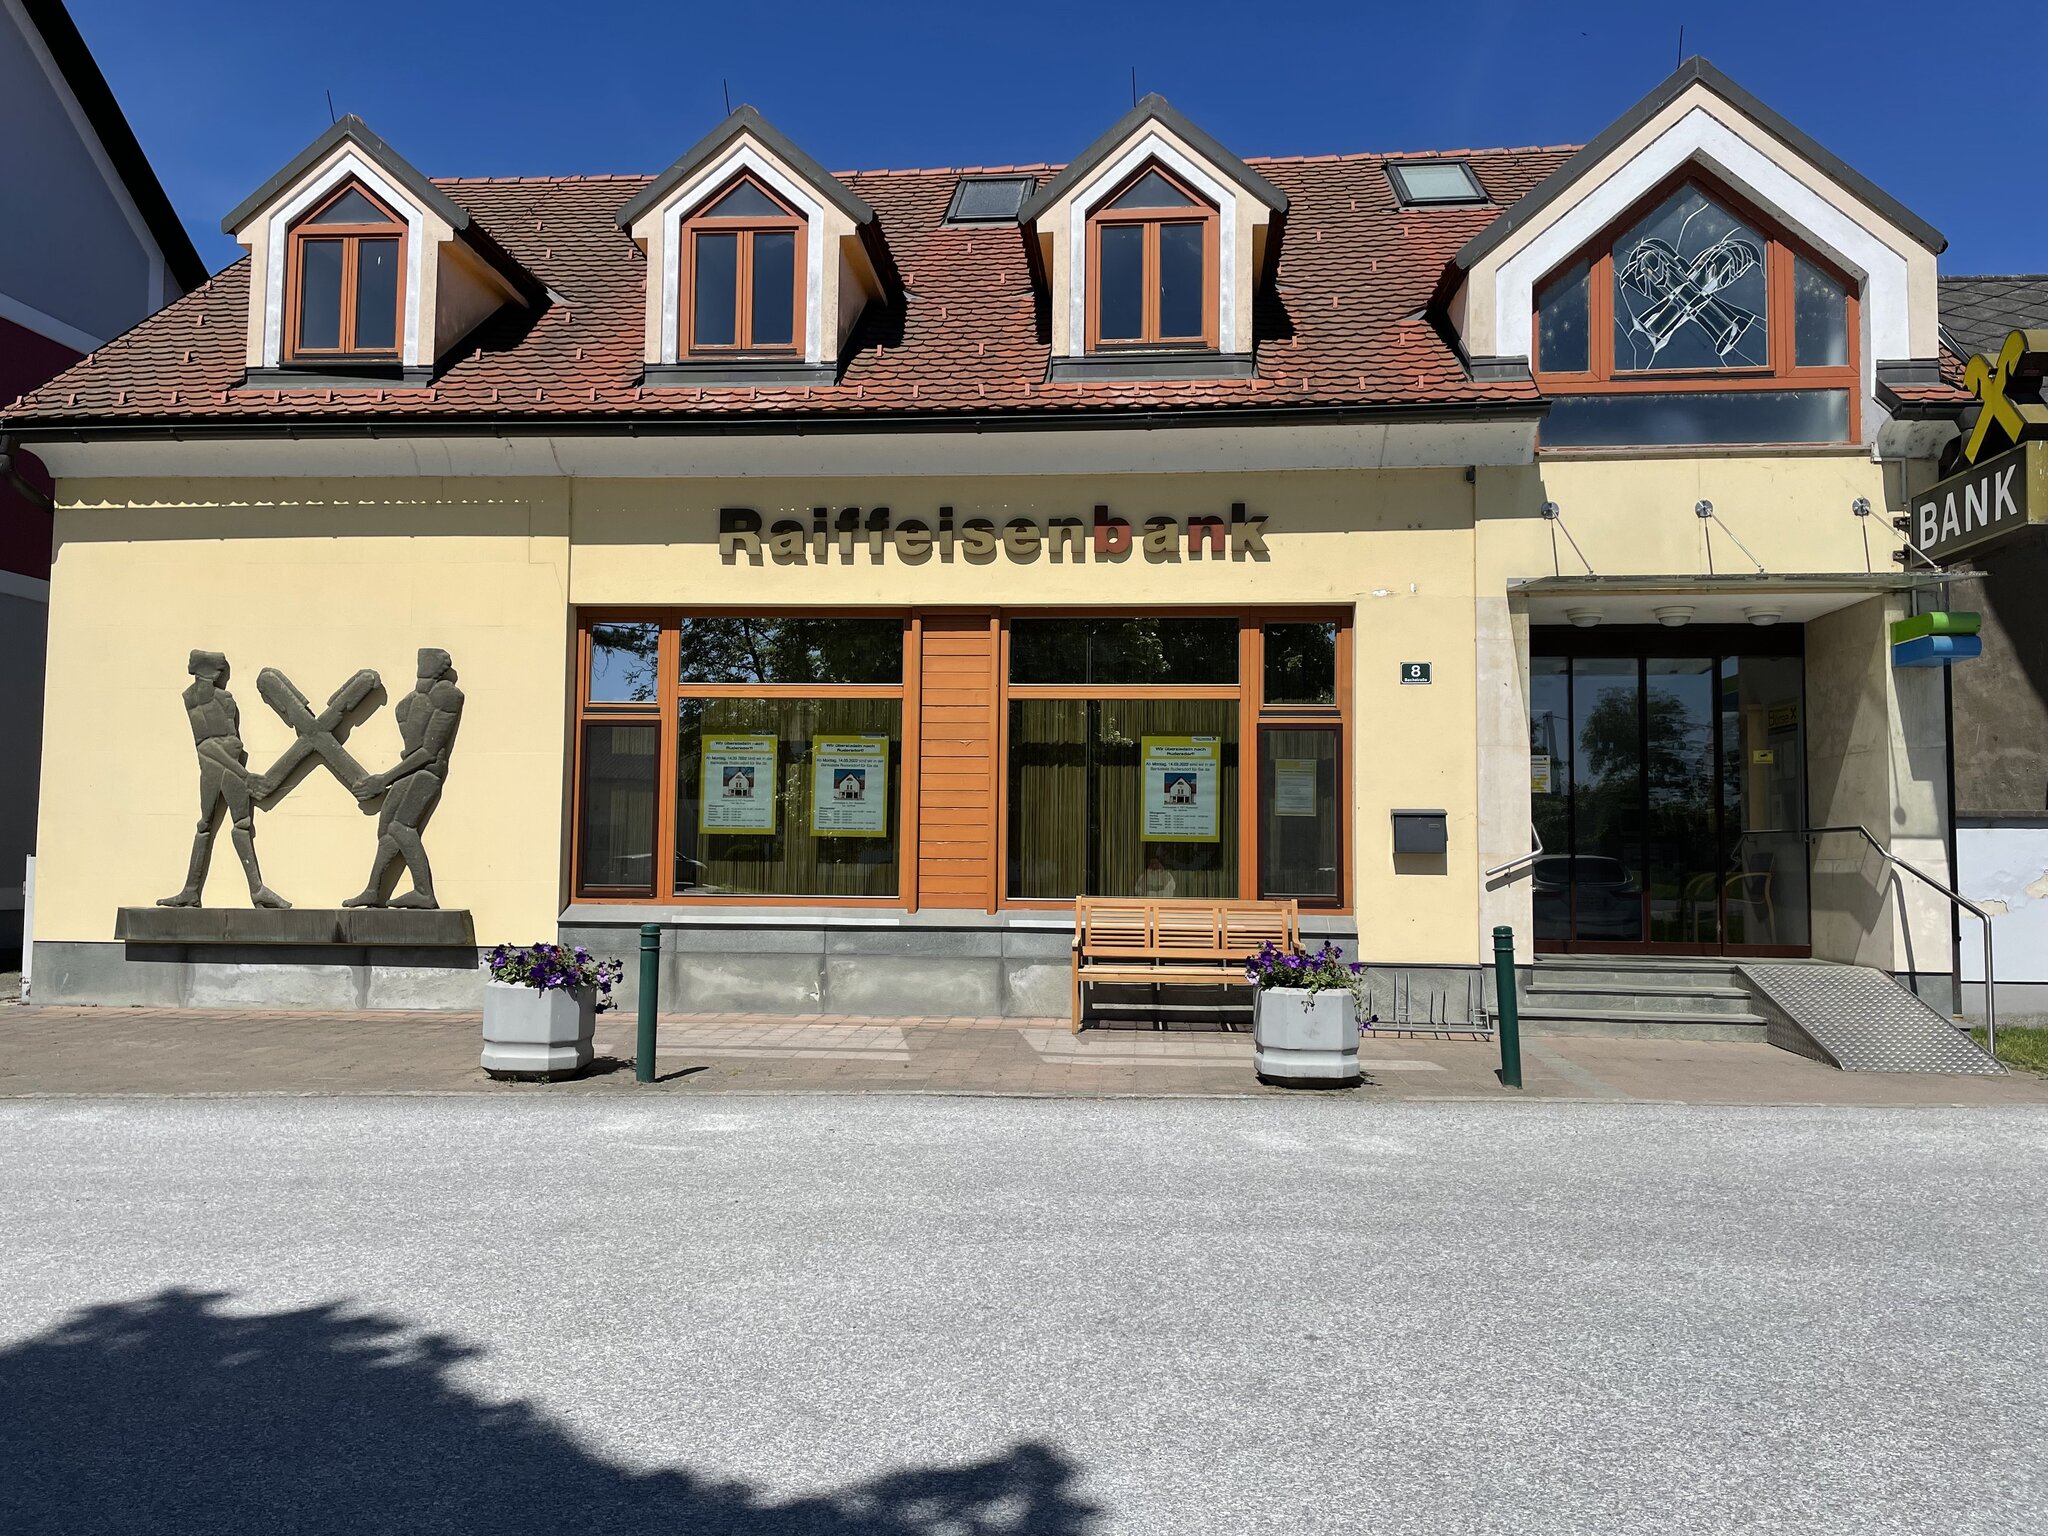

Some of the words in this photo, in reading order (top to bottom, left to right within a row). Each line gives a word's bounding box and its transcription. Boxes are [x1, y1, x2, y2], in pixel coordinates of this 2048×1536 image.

[718, 503, 1270, 559] Raiffeisenbank
[1919, 463, 2018, 551] BANK
[1411, 665, 1421, 677] 8
